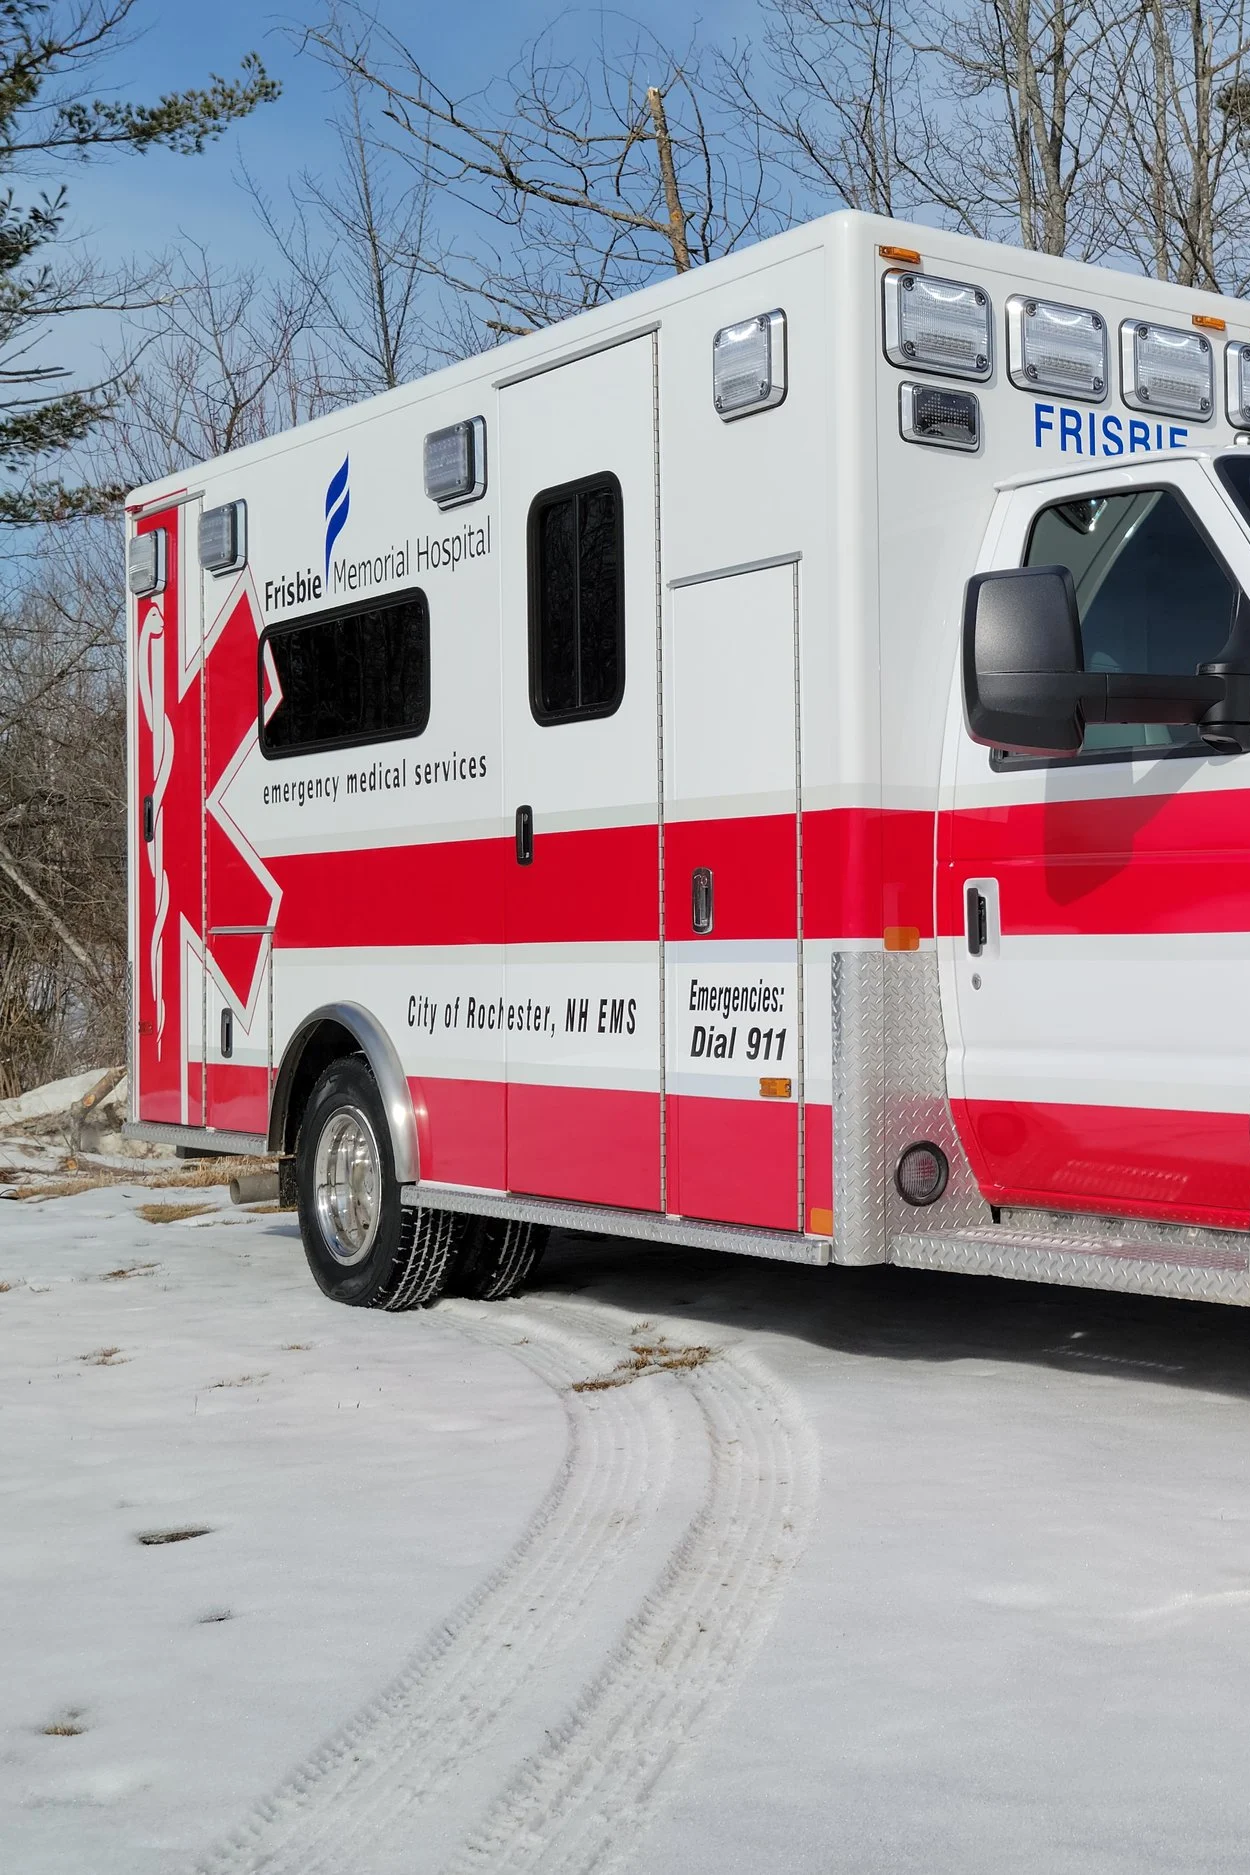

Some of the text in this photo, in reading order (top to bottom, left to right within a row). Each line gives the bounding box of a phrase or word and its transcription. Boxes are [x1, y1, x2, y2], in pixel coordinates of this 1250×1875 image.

[265, 515, 491, 611] Frisbie Memorial Hospital
[263, 751, 487, 806] emergency medical services
[407, 995, 637, 1038] City of Rochester, NH EMS
[689, 979, 785, 1020] Emergencies:
[690, 1025, 787, 1061] Dial 911
